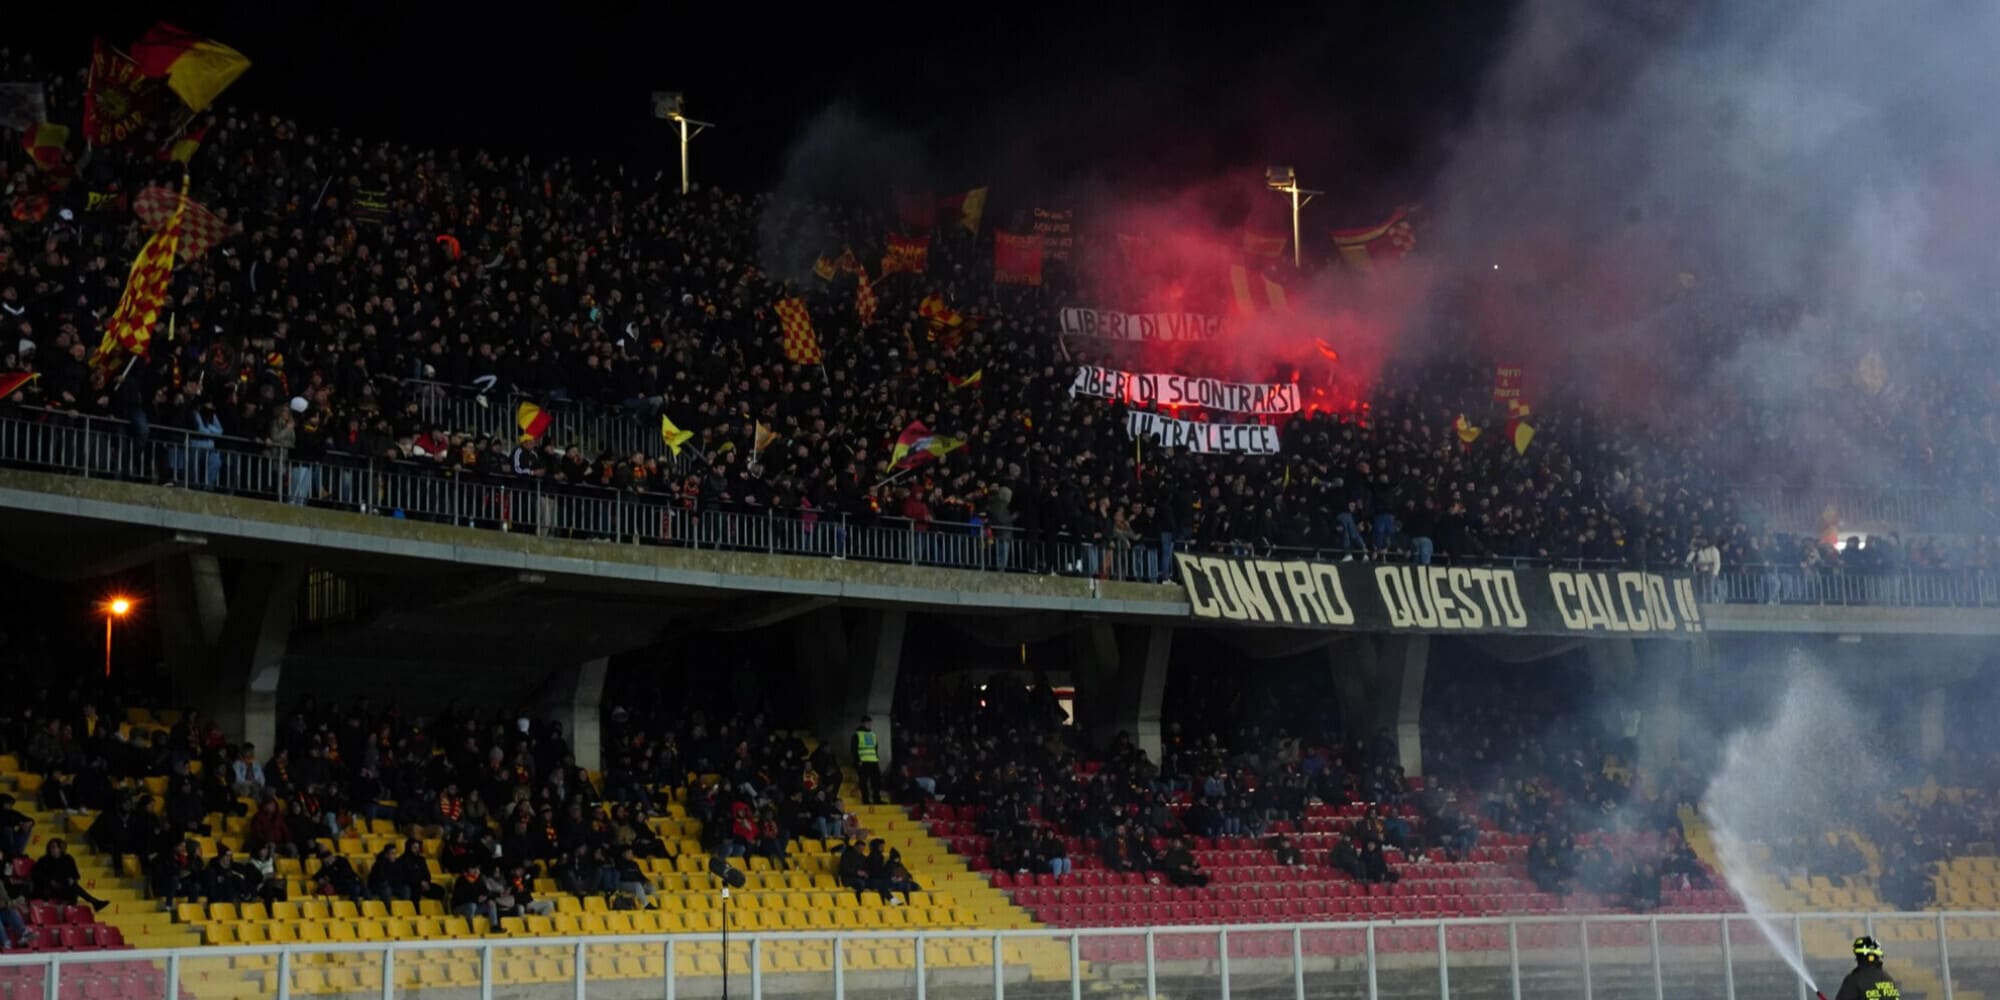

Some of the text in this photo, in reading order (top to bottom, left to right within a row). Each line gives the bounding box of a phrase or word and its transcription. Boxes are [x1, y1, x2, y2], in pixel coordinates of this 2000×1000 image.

[1064, 308, 1129, 340] LIBERI
[1139, 314, 1159, 340] DI
[1138, 375, 1158, 401] DI
[1168, 376, 1295, 412] SCONTRARSI
[1206, 424, 1275, 454] LECCE
[1174, 552, 1354, 624] CONTRO
[1374, 566, 1528, 628] QUESTO
[1550, 572, 1676, 631] CALCIO
